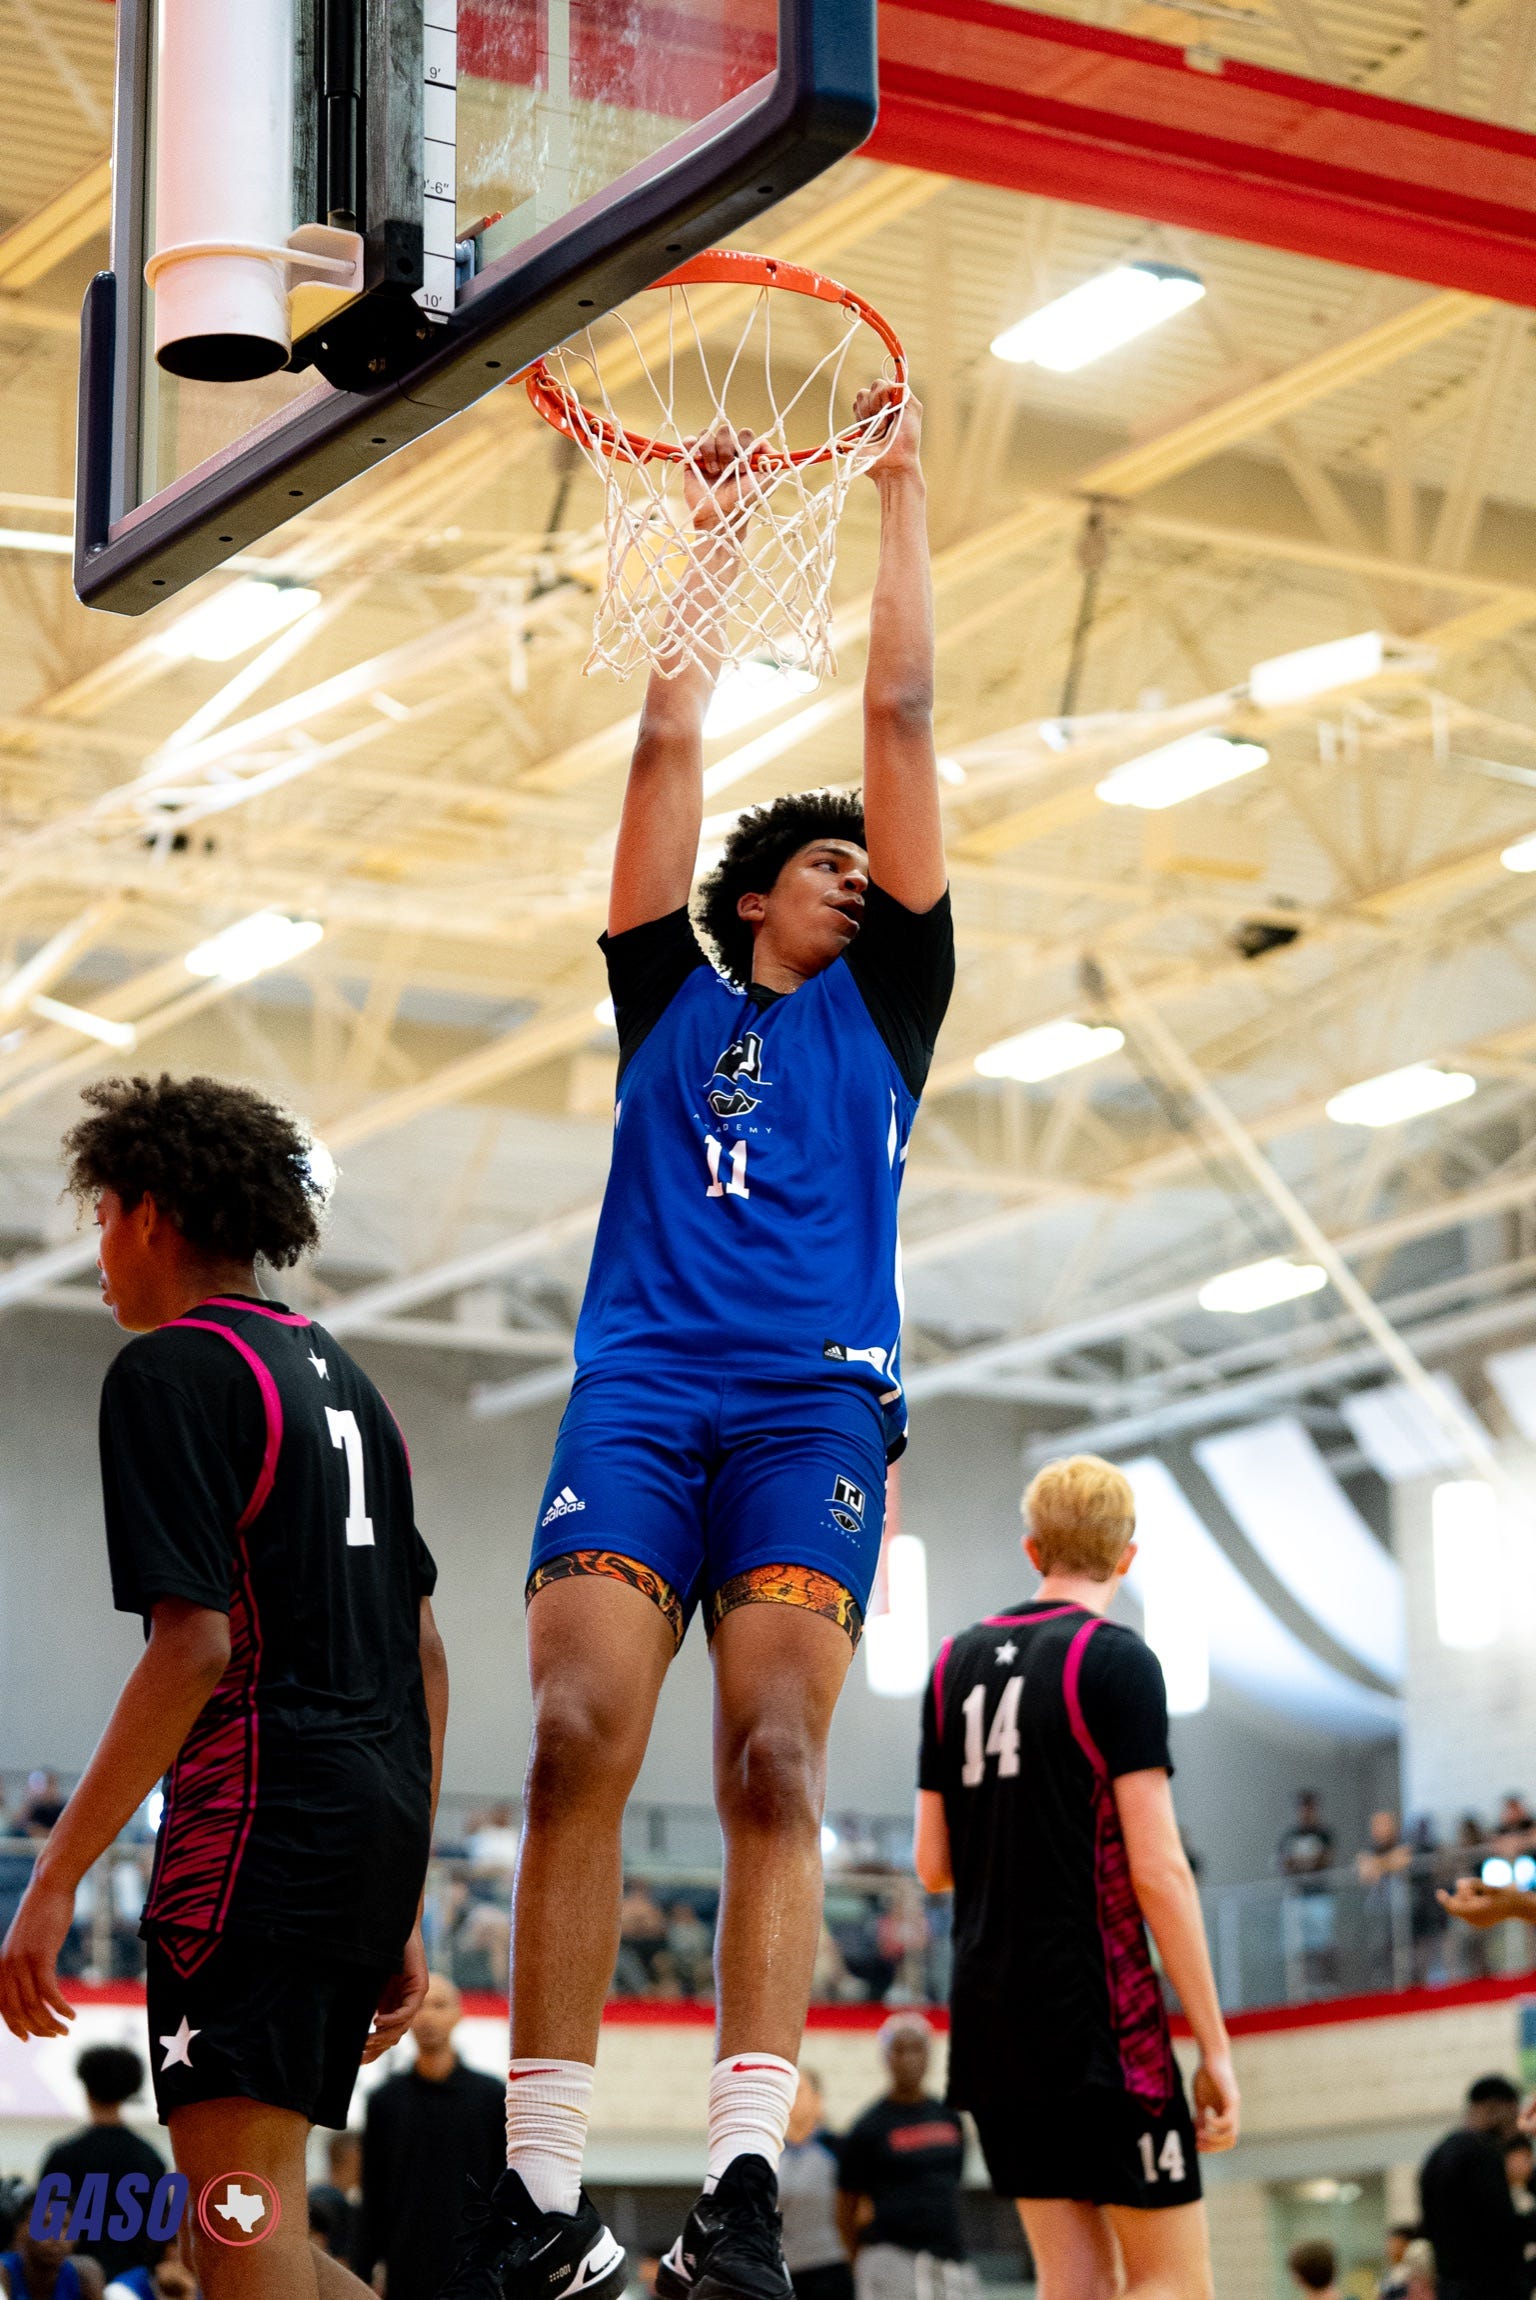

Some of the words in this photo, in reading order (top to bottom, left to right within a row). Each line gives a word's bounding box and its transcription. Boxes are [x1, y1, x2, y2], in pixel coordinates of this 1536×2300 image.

[429, 66, 441, 79] 9'
[423, 179, 449, 194] '-6"
[424, 293, 442, 307] 10'
[704, 1134, 750, 1200] 11
[840, 1479, 863, 1513] TJ
[541, 1501, 586, 1527] adidas
[962, 1676, 1024, 1787] 14
[1137, 2129, 1186, 2183] 14
